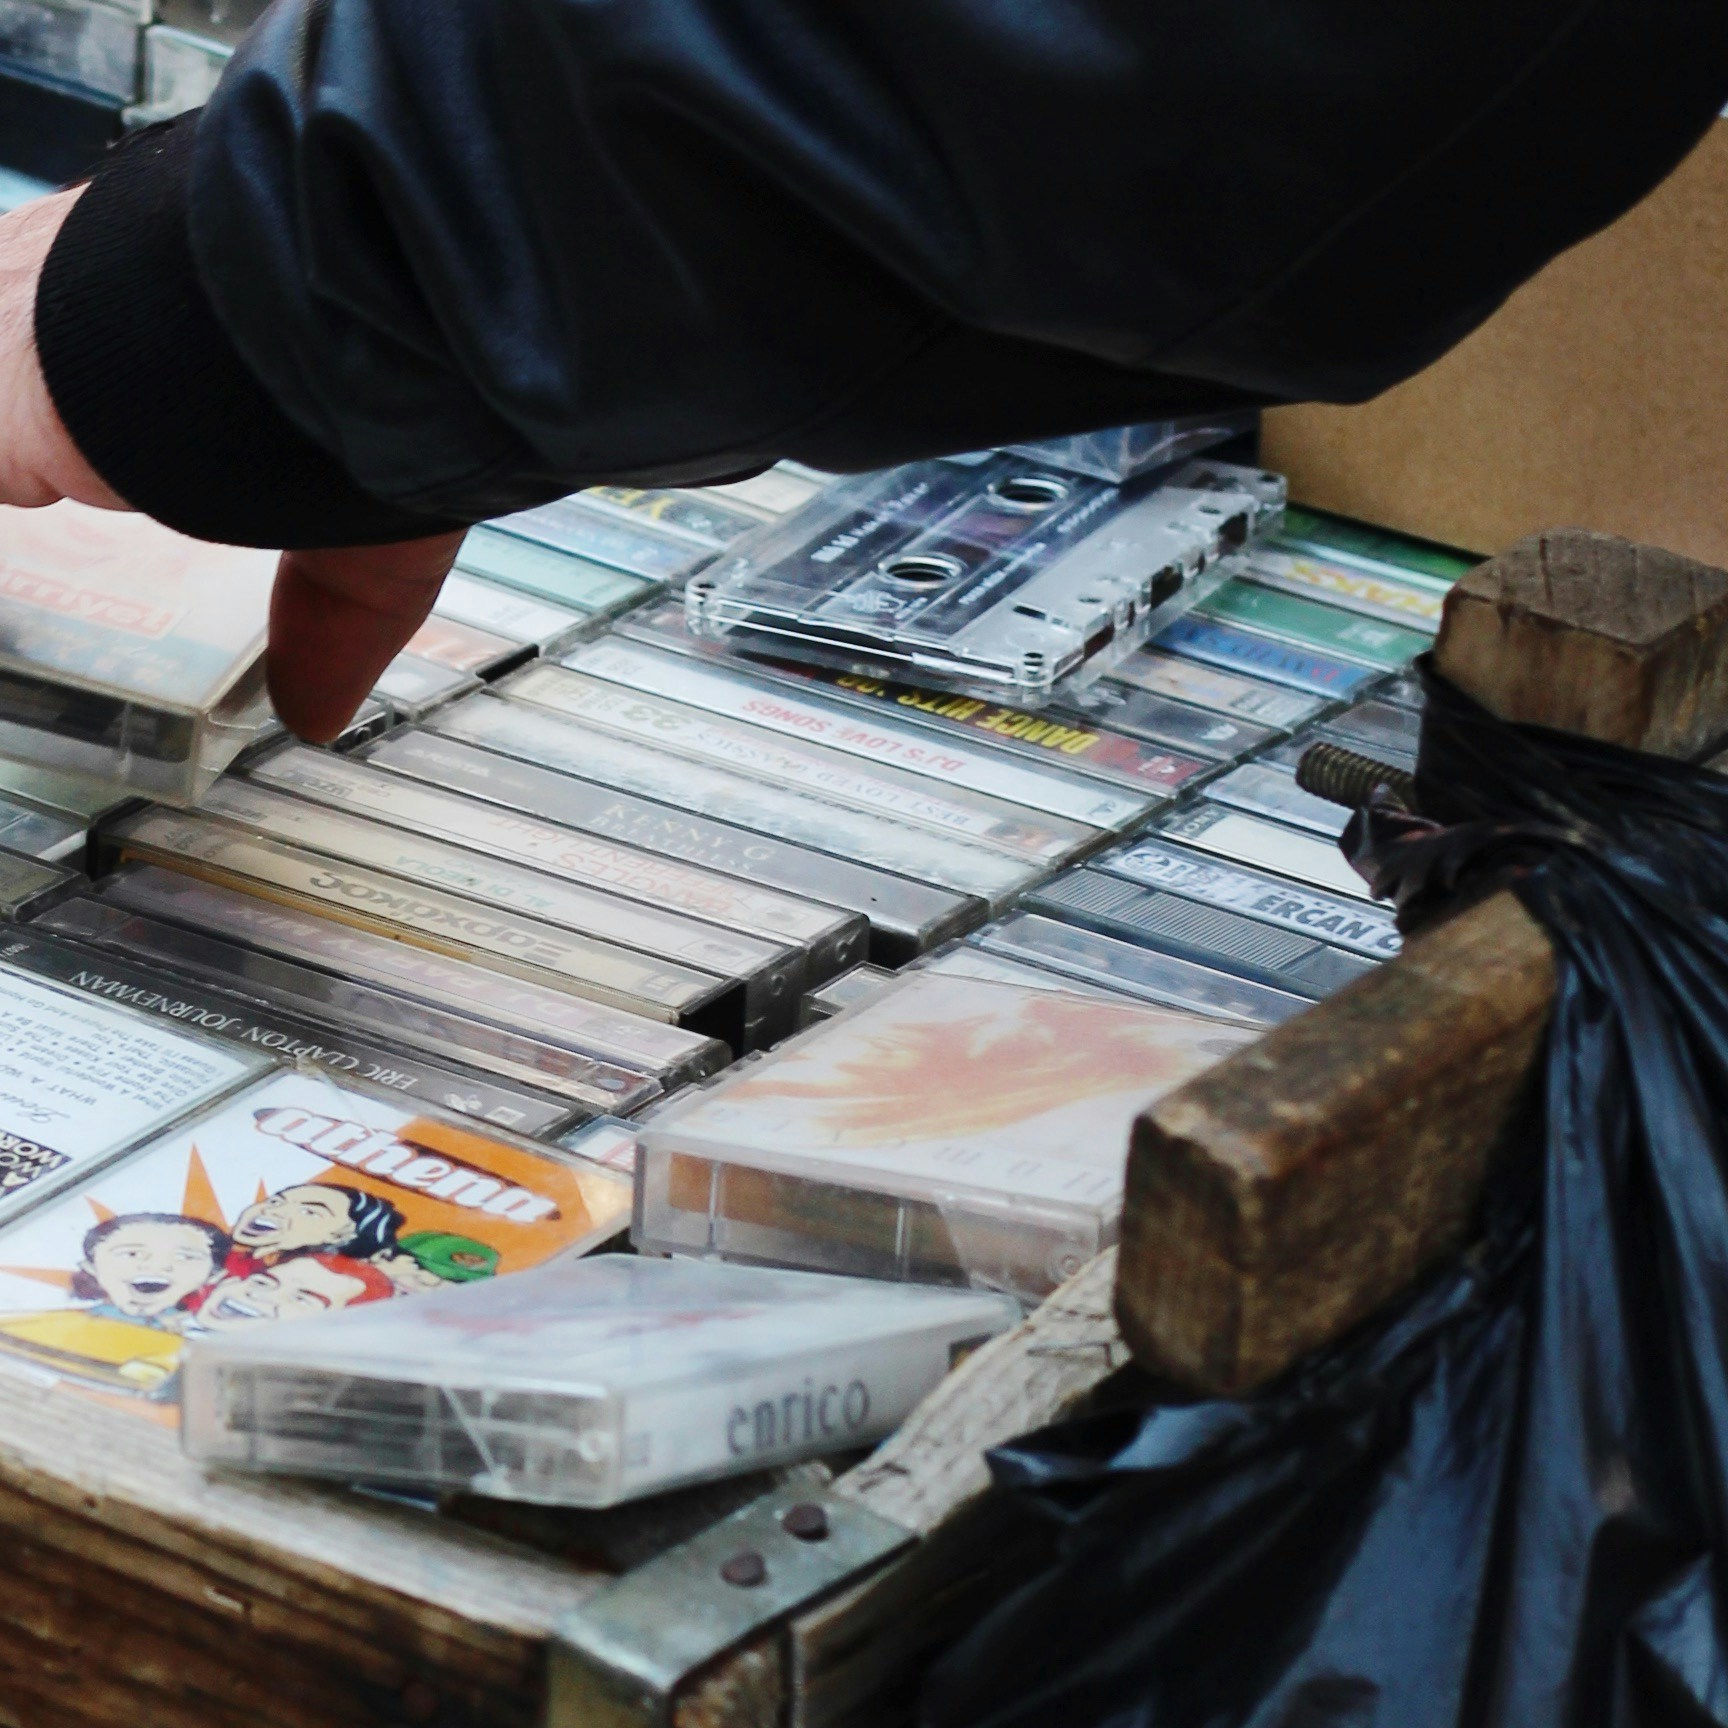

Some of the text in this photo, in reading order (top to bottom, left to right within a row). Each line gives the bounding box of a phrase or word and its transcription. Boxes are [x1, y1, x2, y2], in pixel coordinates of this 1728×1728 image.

[740, 698, 966, 773] DJ'S LOVE SONGS
[974, 703, 1099, 757] DANCE
[816, 770, 899, 803] LOVED
[910, 801, 970, 824] BEST
[602, 801, 775, 861] KENNY G
[394, 856, 553, 908] AL DI MEOLA
[555, 851, 733, 914] BANGLES
[226, 901, 319, 941] MIX
[1249, 893, 1372, 940] ERCAN
[319, 927, 487, 994] PARTY
[11, 1016, 34, 1025] Be
[68, 966, 417, 1089] ERIC CLAPTON JOURNEYMAN
[25, 1075, 45, 1084] A
[100, 1060, 135, 1074] Your
[45, 1083, 101, 1105] WHAT
[258, 1106, 558, 1221] athena
[728, 1376, 870, 1455] enrico
